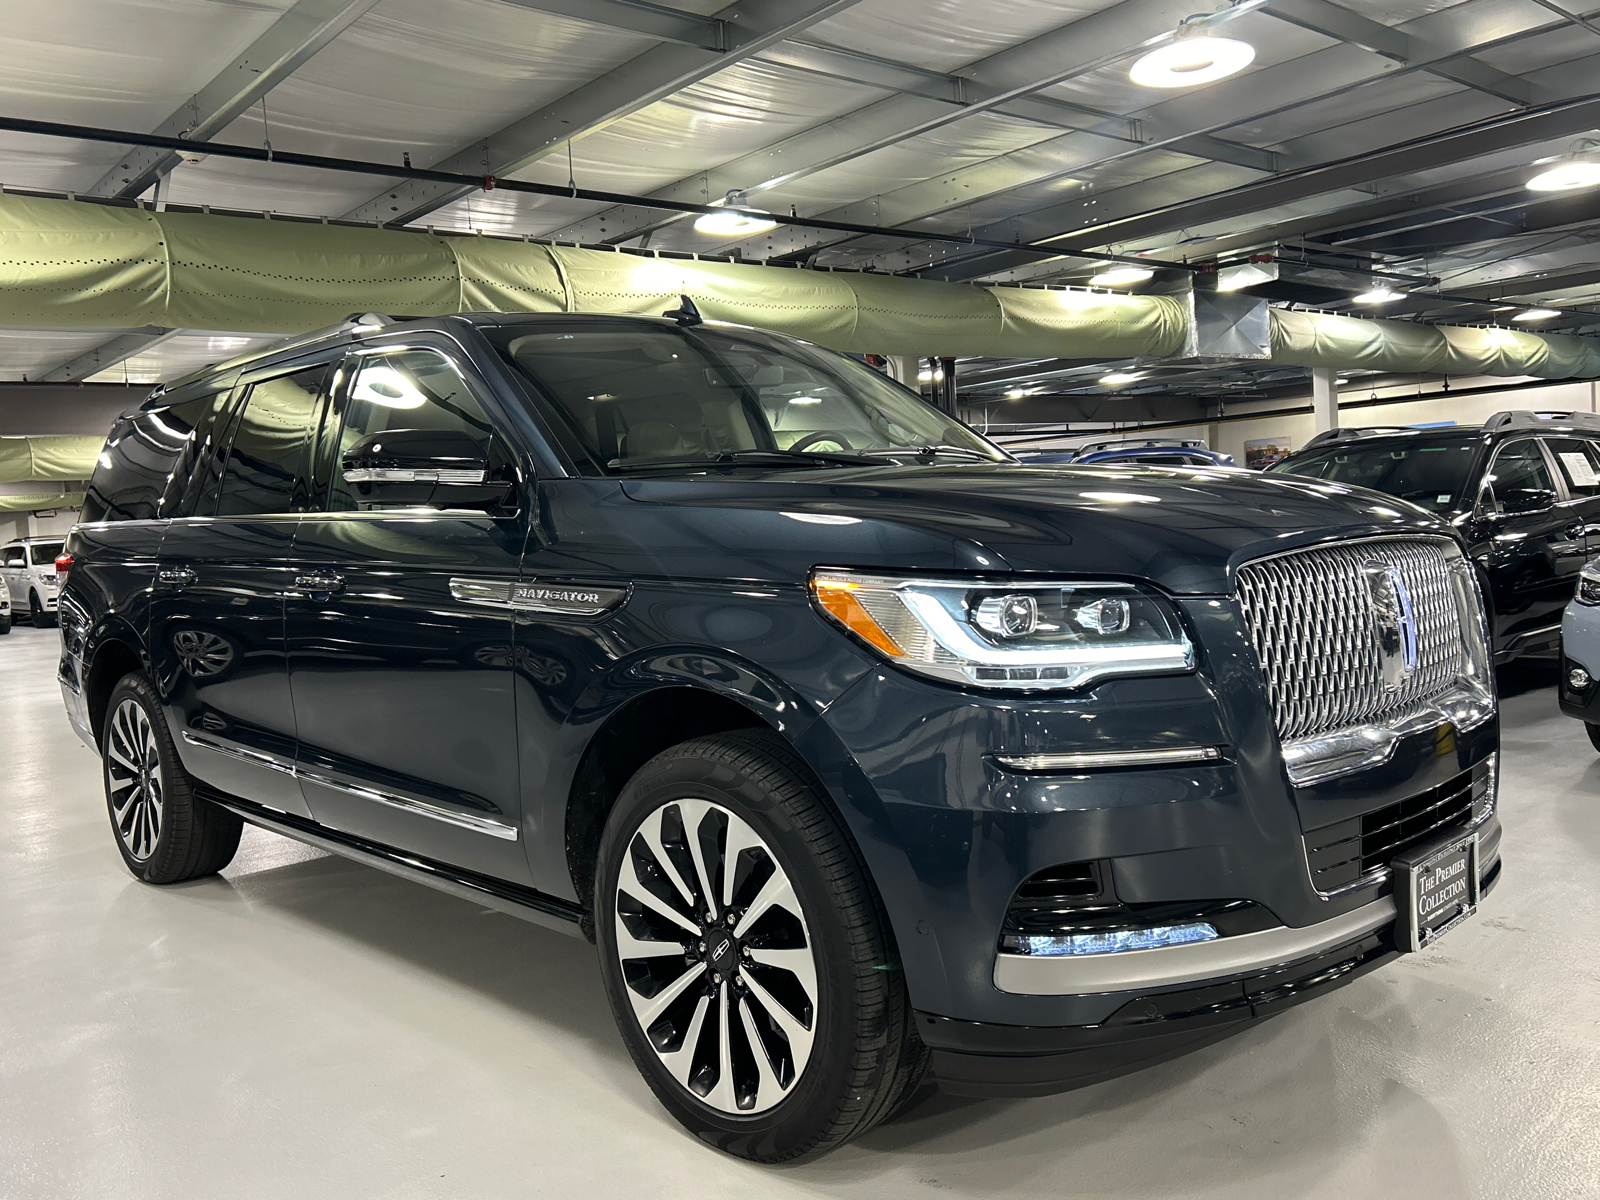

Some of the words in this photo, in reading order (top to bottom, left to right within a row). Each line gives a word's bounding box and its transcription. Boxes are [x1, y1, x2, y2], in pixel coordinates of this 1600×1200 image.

[518, 588, 599, 603] NAVIGATOR
[1420, 876, 1434, 895] THE
[1435, 859, 1466, 885] PREMIER
[1419, 877, 1466, 915] COLLECTION
